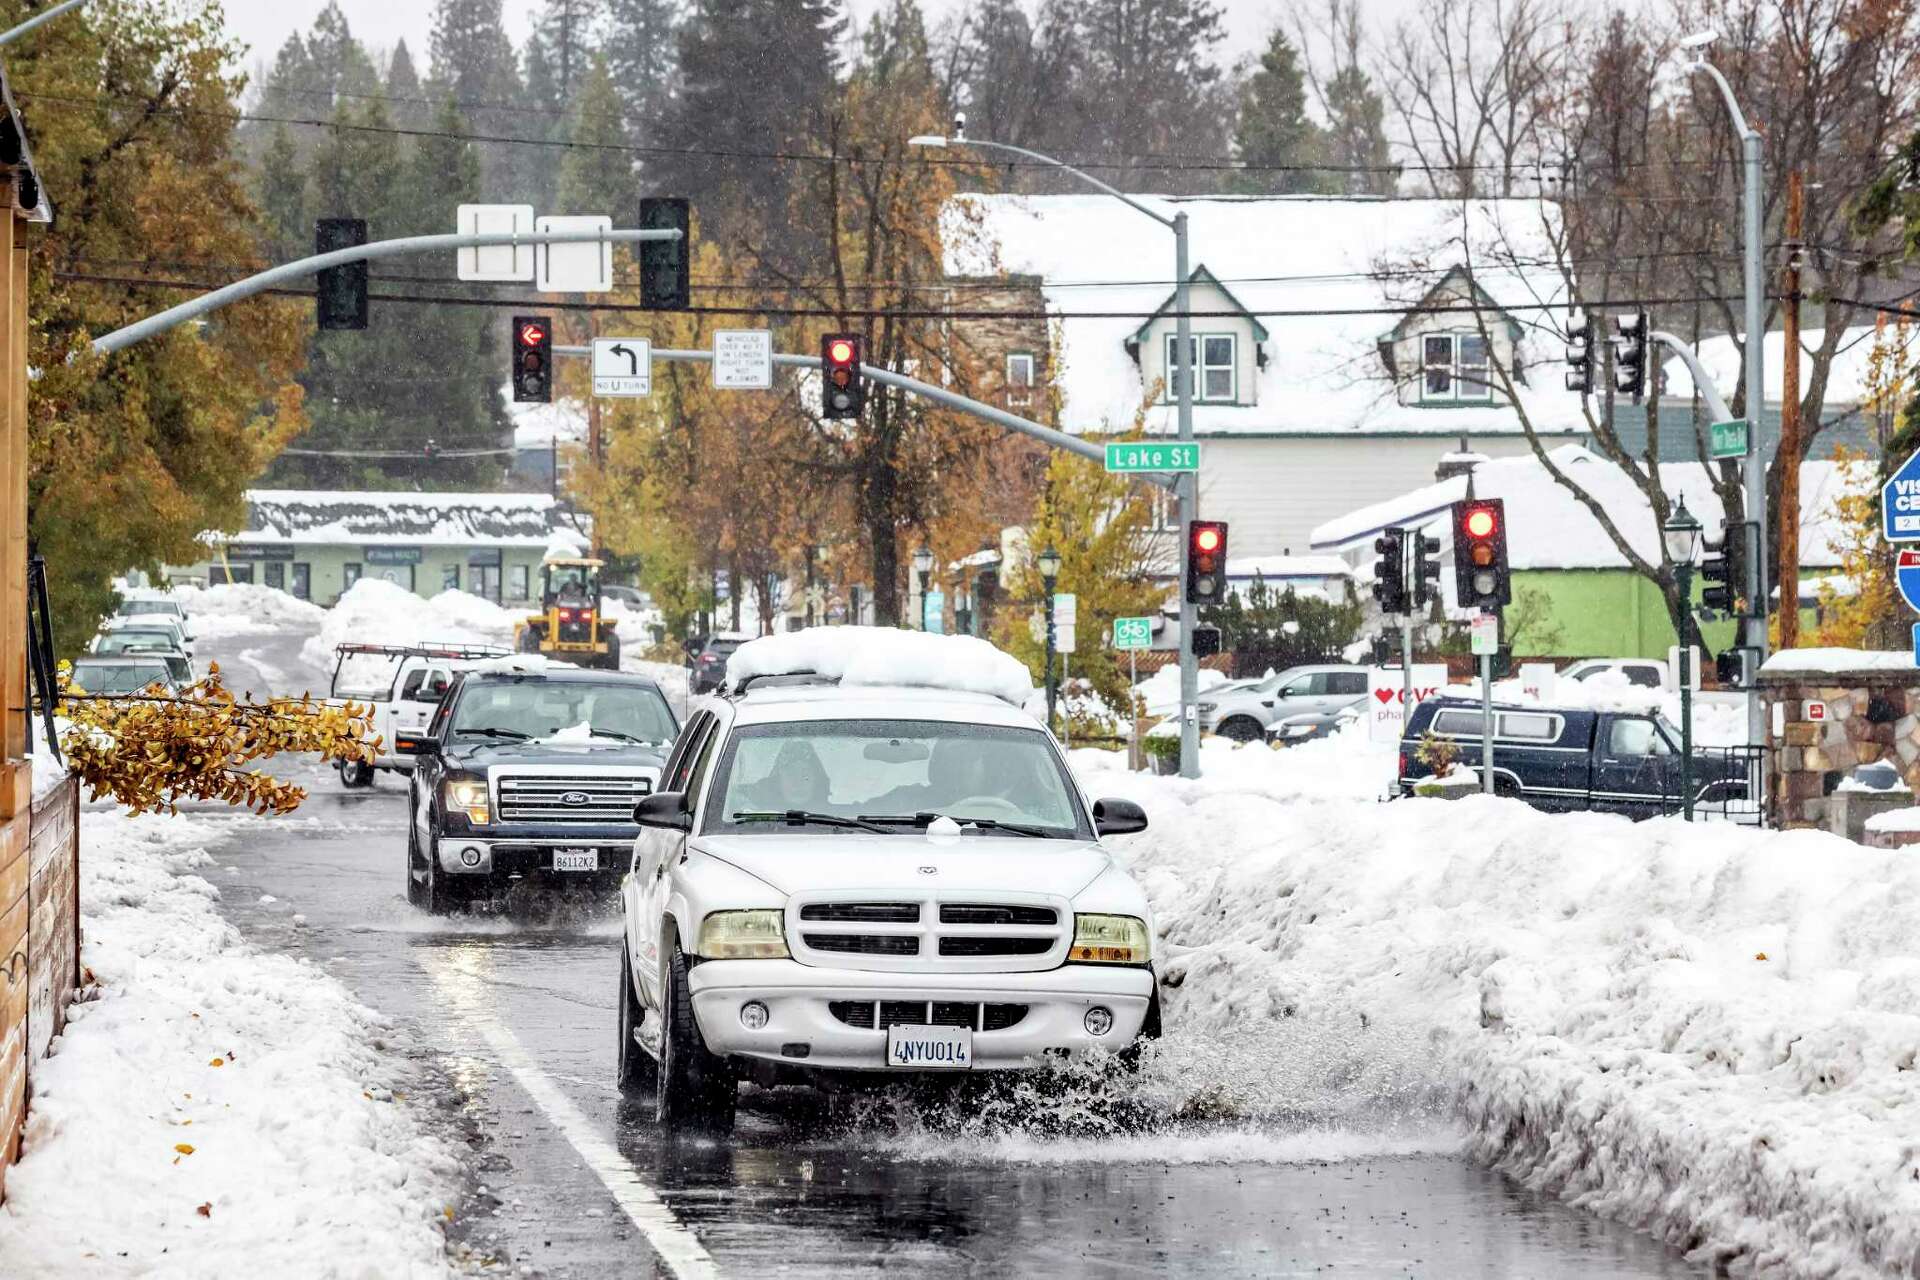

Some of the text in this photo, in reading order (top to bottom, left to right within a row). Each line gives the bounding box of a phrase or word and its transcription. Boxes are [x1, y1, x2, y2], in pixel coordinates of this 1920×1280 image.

[597, 380, 646, 391] NO U TURN
[1115, 447, 1191, 467] Lake St
[566, 793, 585, 803] Ford
[894, 1040, 966, 1062] 4NYU014
